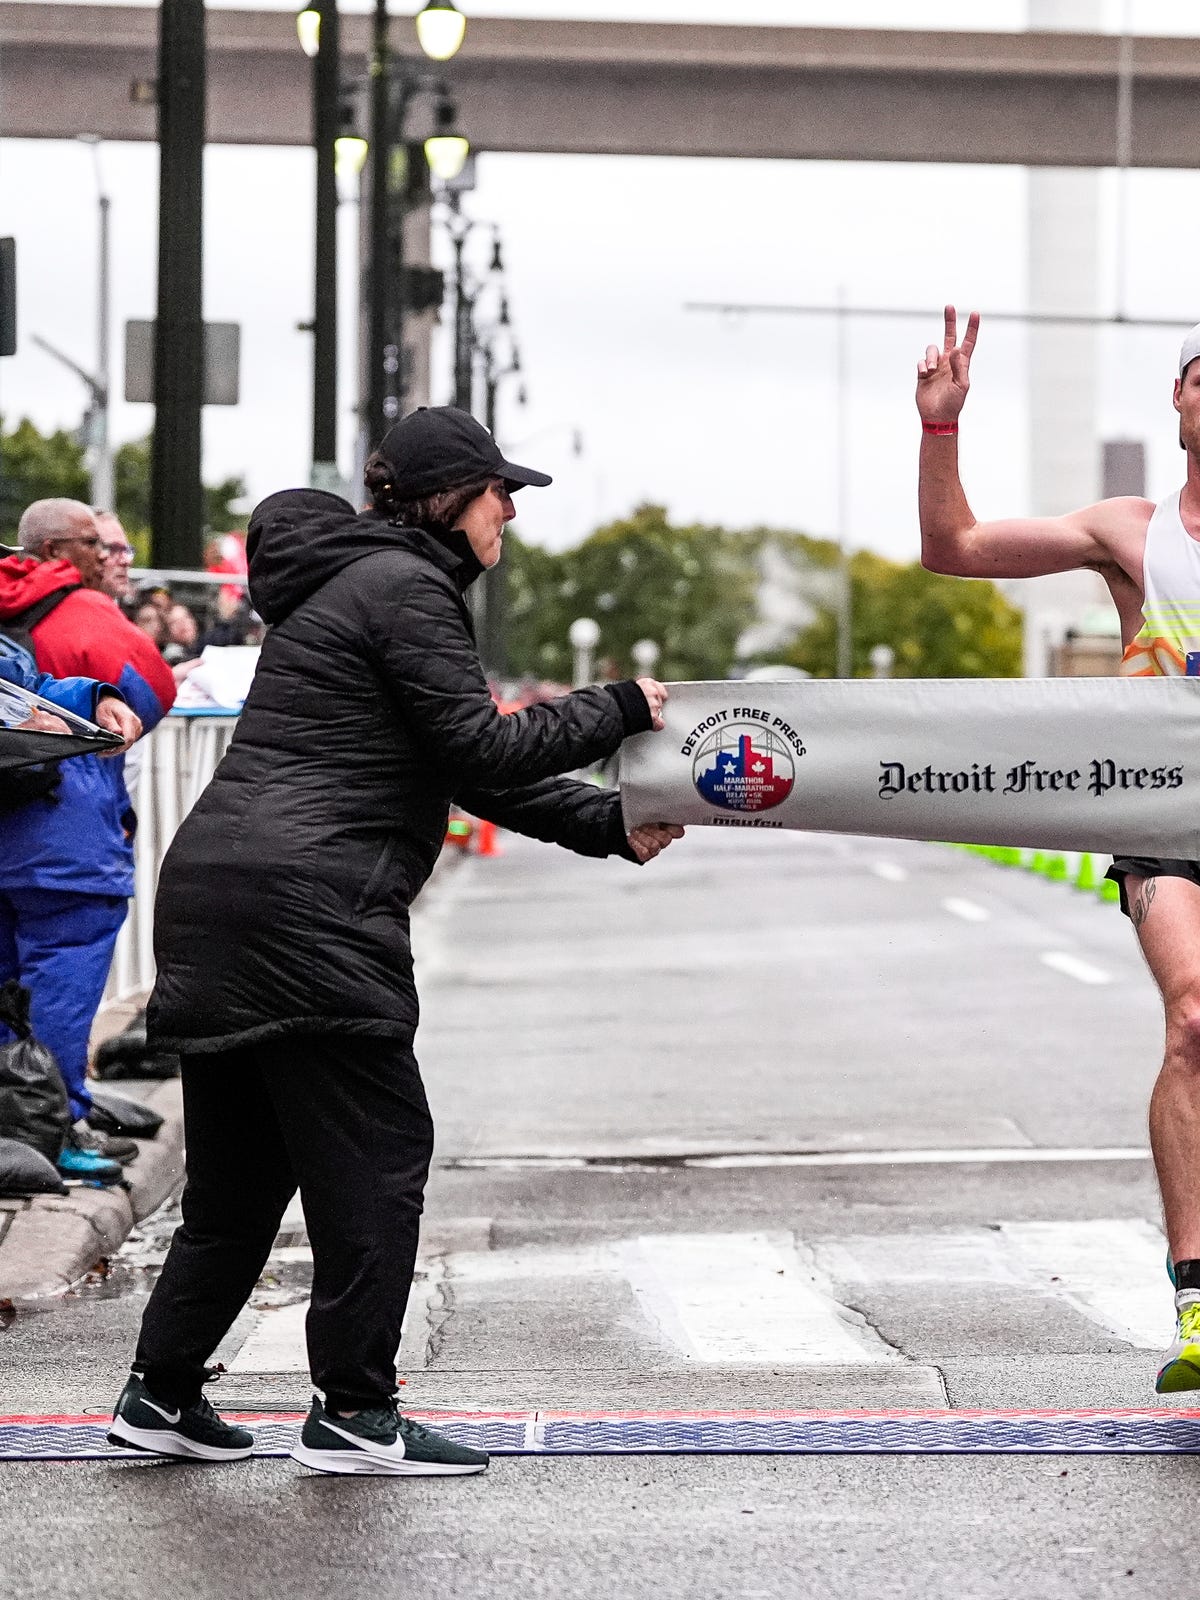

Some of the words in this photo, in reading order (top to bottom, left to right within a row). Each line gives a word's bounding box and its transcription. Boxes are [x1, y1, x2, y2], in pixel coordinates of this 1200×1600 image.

[680, 710, 728, 757] DETROIT
[733, 708, 771, 722] FREE
[772, 717, 807, 757] PRESS
[878, 759, 997, 800] Detroit
[1002, 760, 1082, 797] Free
[1087, 757, 1184, 798] Press
